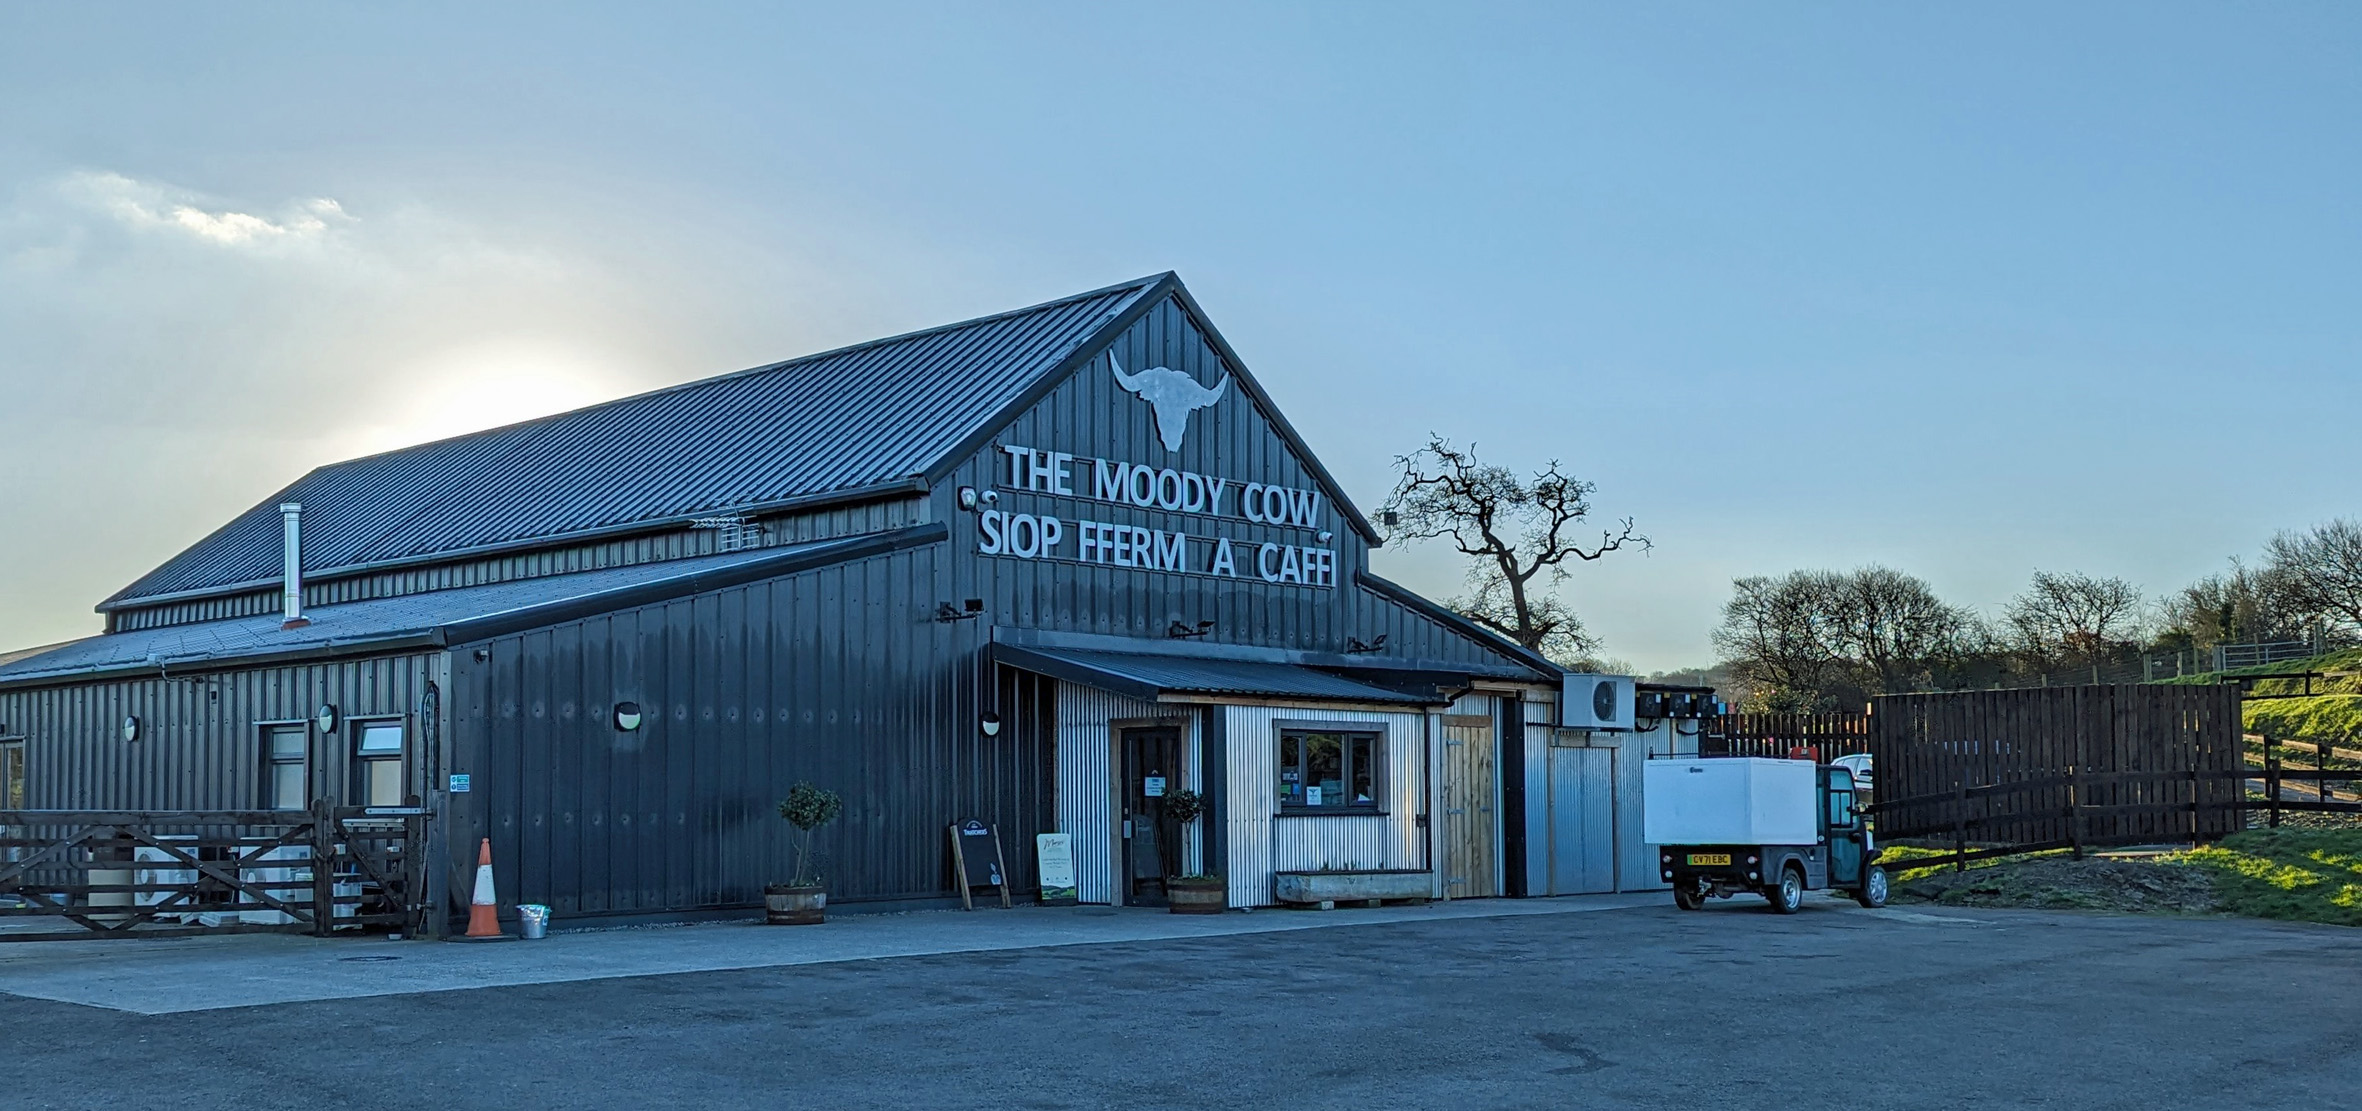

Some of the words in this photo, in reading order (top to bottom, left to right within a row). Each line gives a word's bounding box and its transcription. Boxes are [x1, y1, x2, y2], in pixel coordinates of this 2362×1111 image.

[1004, 445, 1073, 496] THE
[1095, 458, 1226, 516] MOODY
[1243, 482, 1321, 528] COW
[980, 509, 1062, 559] SIOP
[1079, 520, 1186, 573] FFERM
[1212, 537, 1237, 578] A
[1259, 542, 1337, 588] CAFFI
